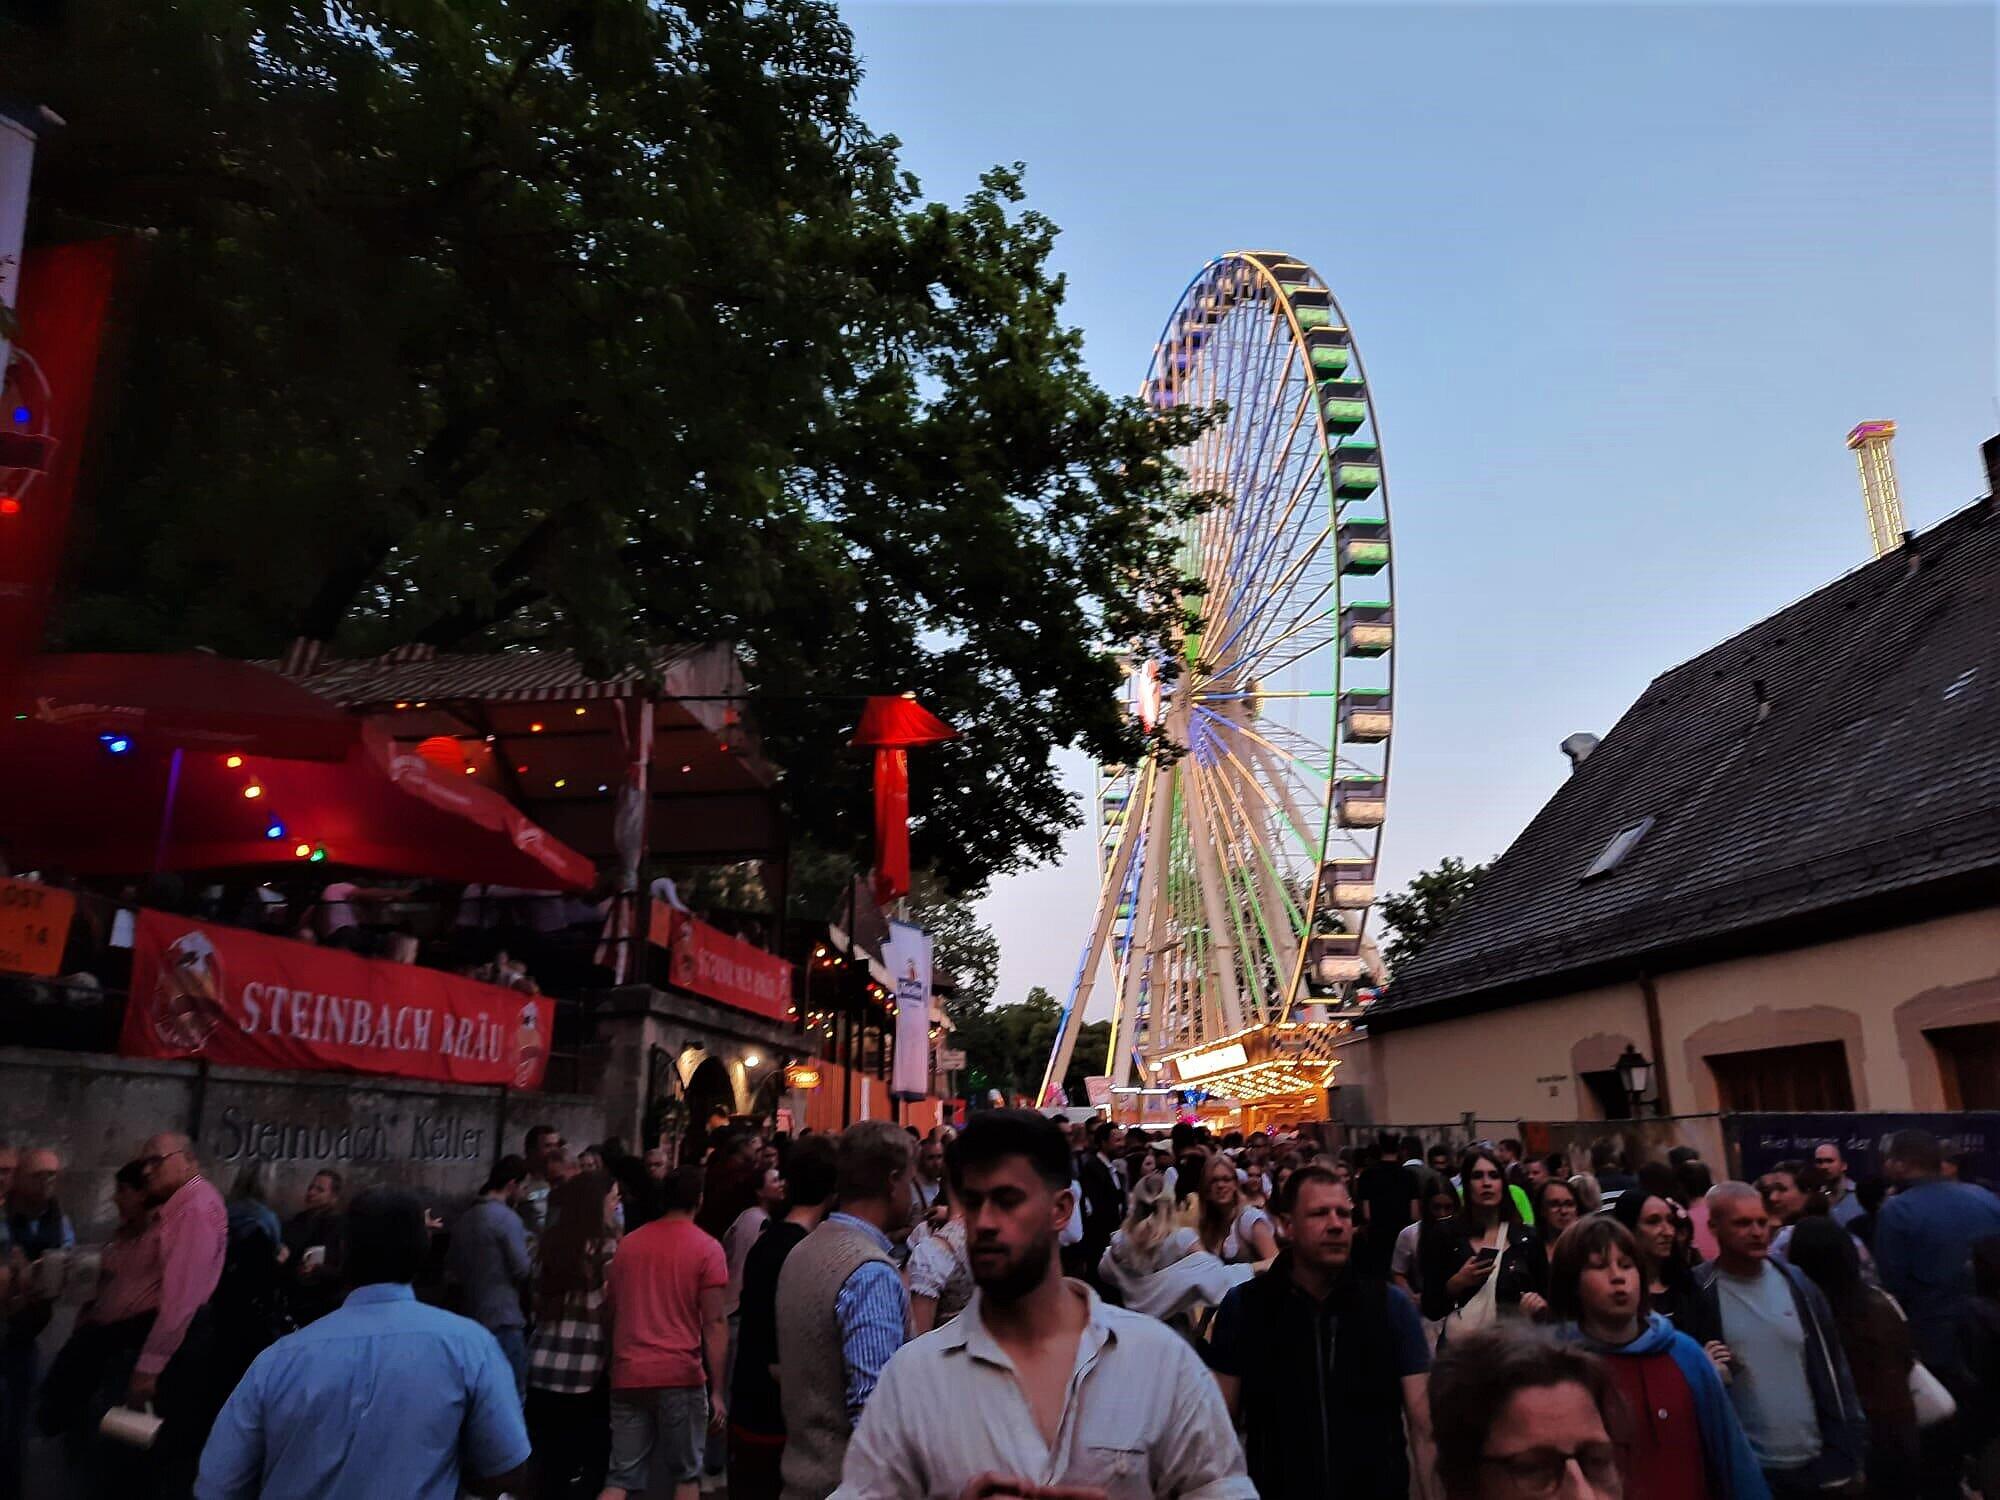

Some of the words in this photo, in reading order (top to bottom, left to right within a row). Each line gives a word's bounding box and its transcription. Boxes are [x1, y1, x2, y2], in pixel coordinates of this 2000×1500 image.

[240, 982, 432, 1049] STEINBACH
[440, 1012, 505, 1063] BRÄU
[218, 1106, 388, 1161] Steinbach
[411, 1115, 487, 1161] Keller
